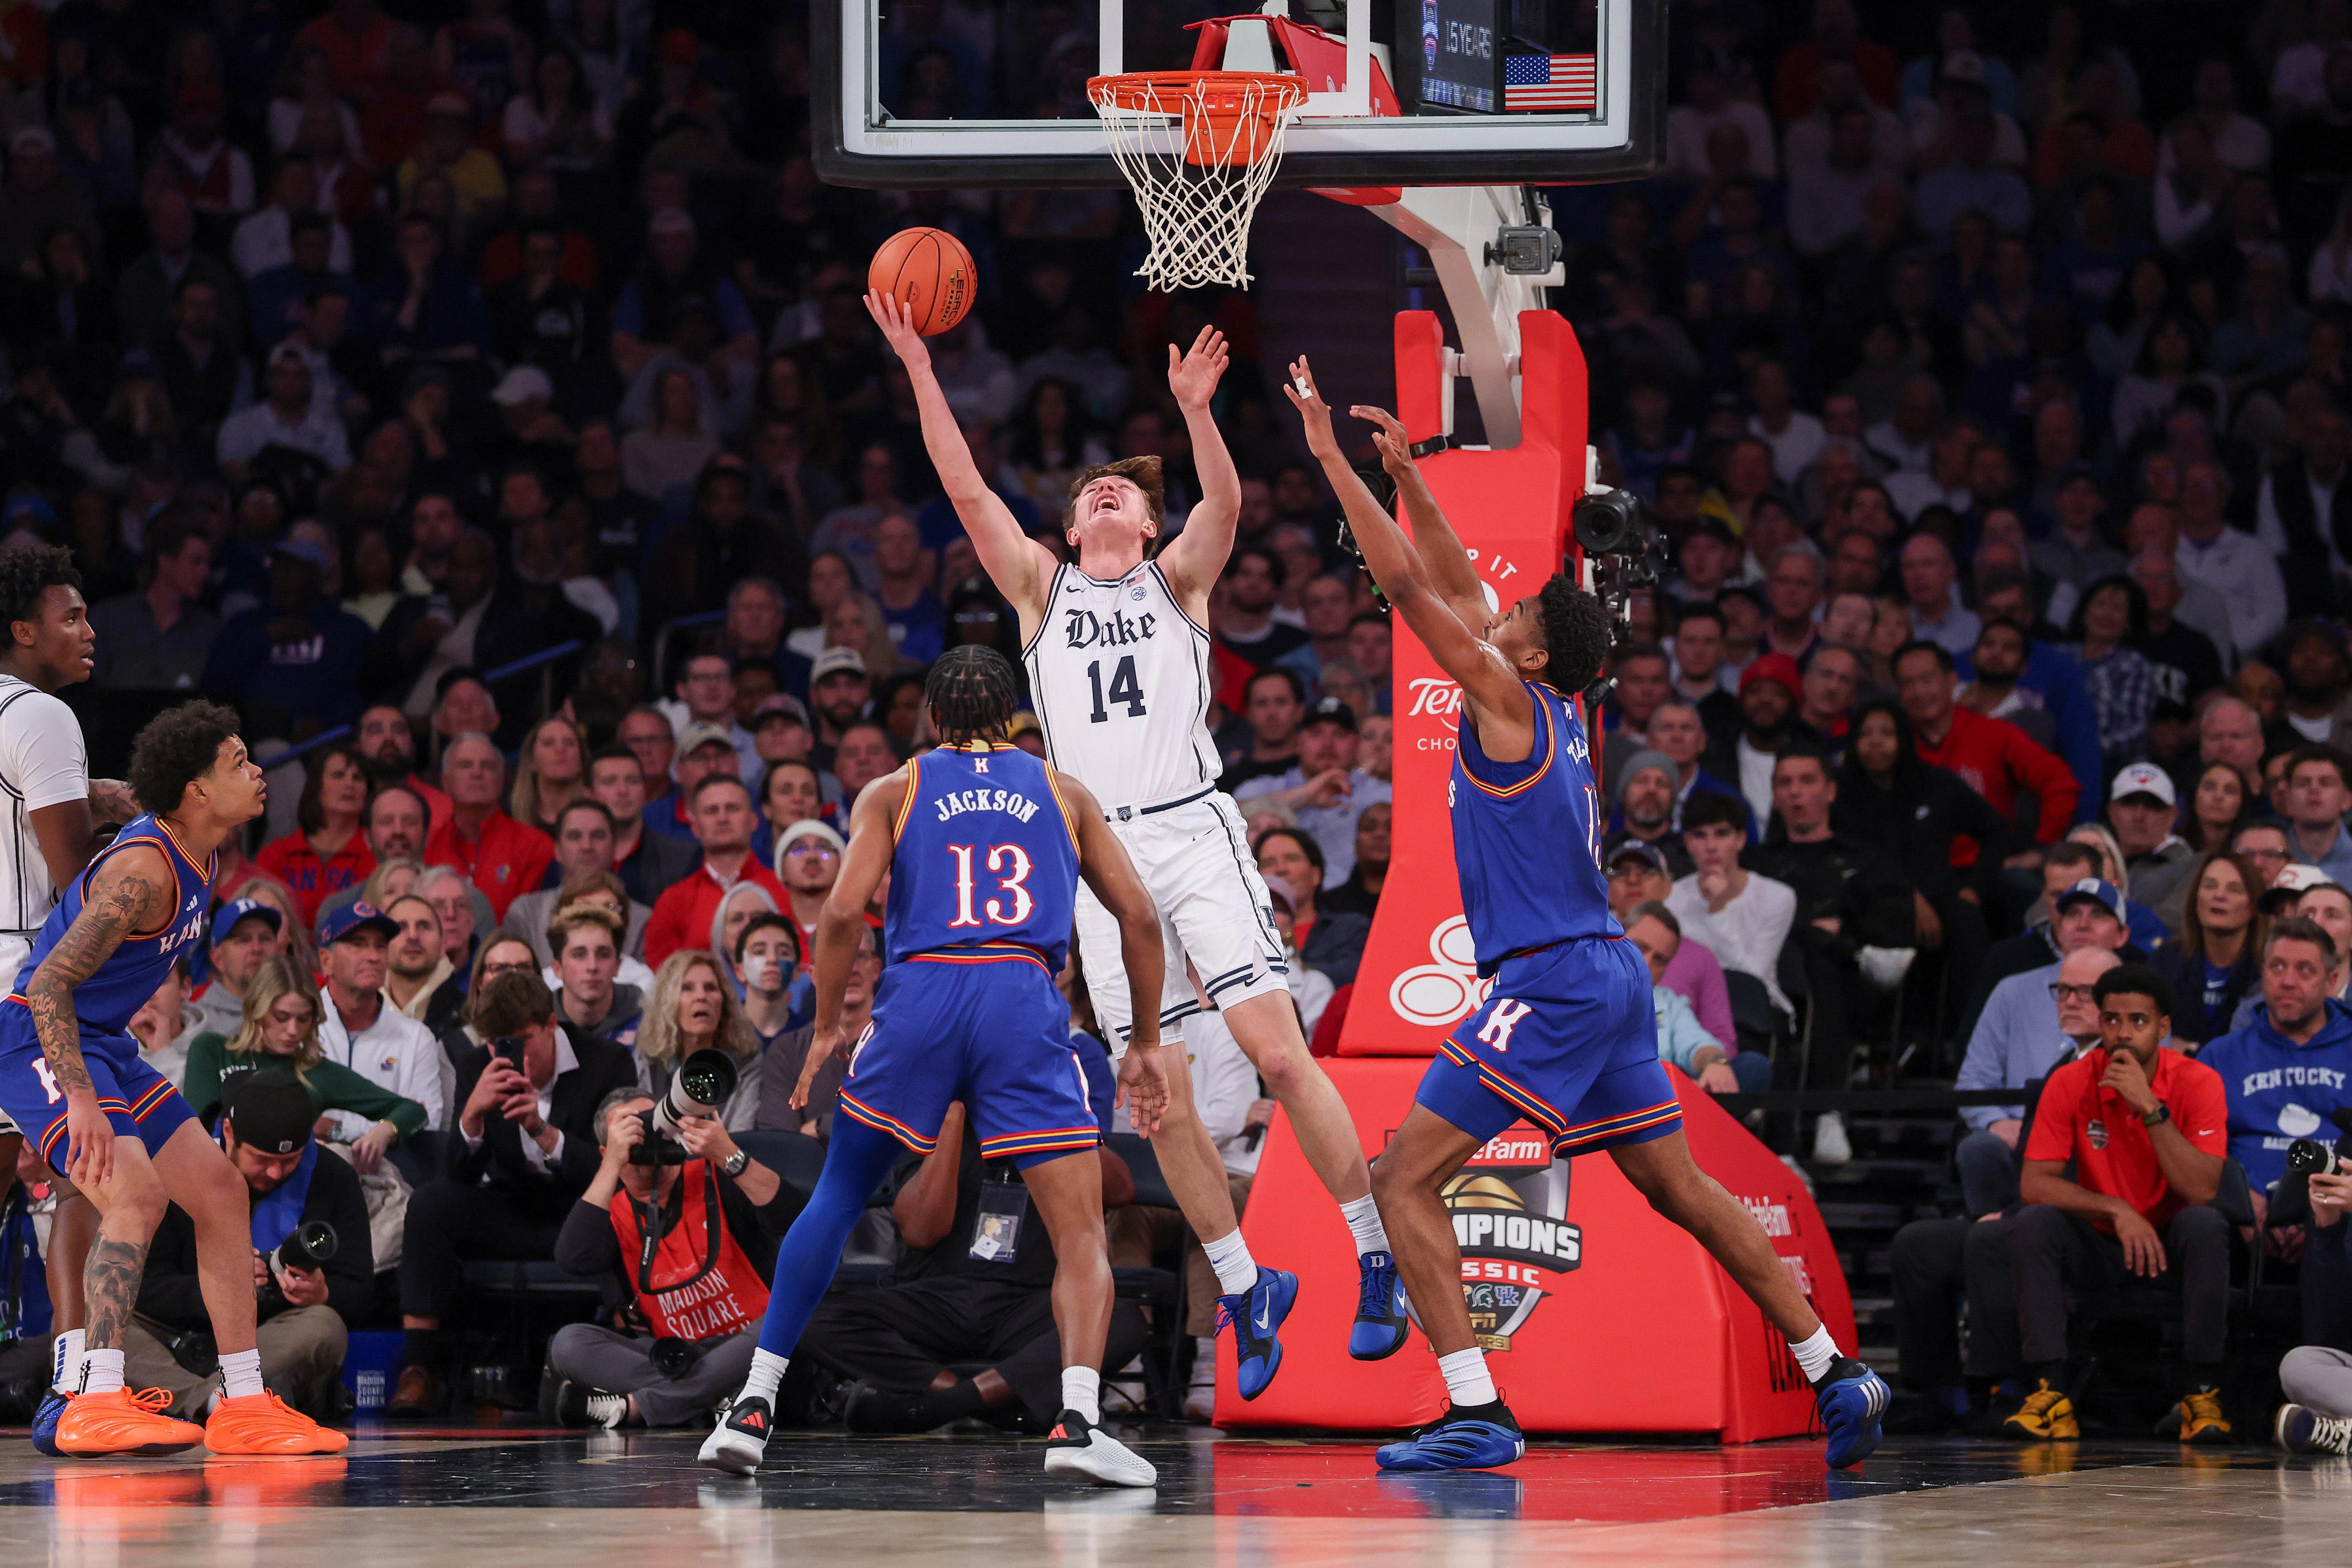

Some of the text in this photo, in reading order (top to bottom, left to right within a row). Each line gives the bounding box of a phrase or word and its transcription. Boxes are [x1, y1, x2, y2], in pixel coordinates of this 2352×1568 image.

[1490, 555, 1518, 579] IT
[1065, 609, 1156, 649] Duke
[1088, 655, 1146, 723] 14
[974, 758, 989, 773] K
[934, 788, 1040, 824] JACKSON
[947, 843, 1036, 928] 13
[1476, 998, 1533, 1053] K
[1370, 1255, 1385, 1267] D
[667, 1293, 745, 1339] SQUARE
